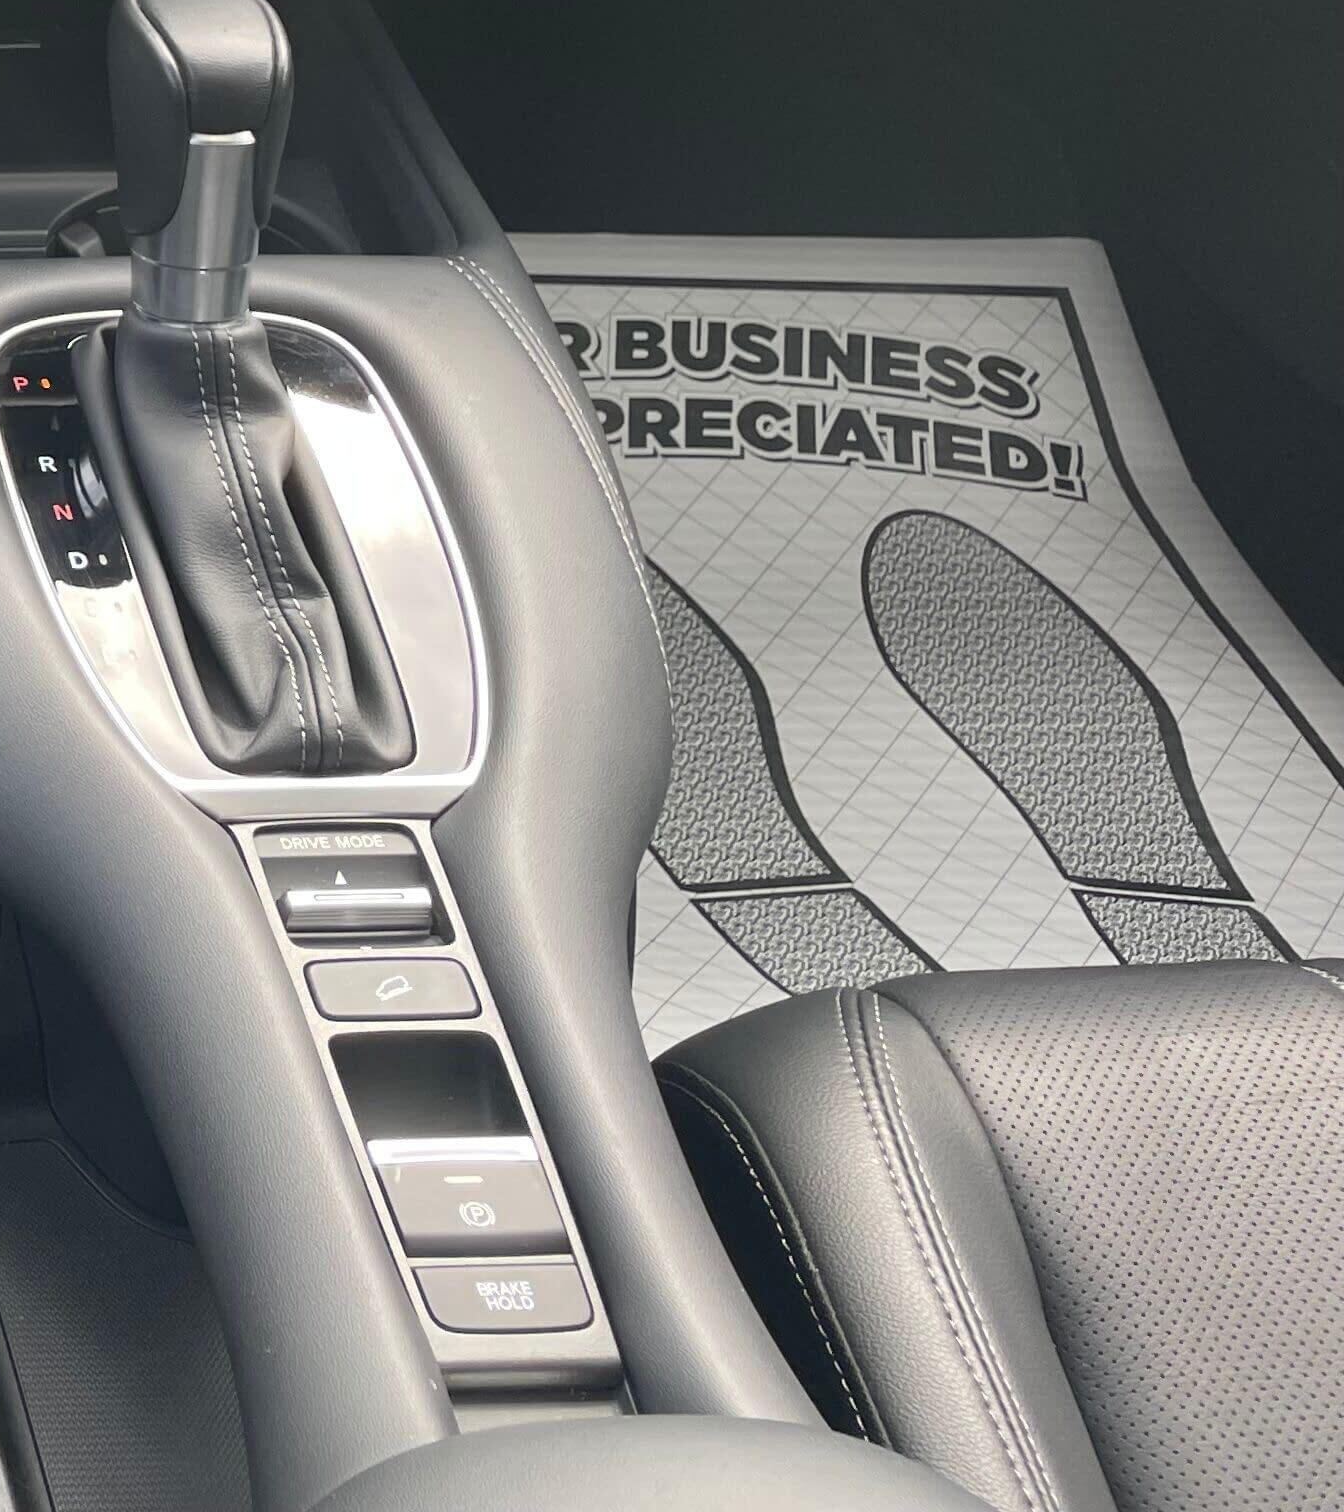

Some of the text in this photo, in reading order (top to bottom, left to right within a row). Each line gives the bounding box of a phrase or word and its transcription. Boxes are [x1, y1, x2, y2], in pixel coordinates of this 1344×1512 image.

[614, 319, 1032, 412] BUSINESS
[12, 375, 29, 392] P
[591, 398, 1080, 492] PRECIATED!
[37, 455, 58, 474] R
[52, 503, 74, 521] N
[67, 551, 89, 570] D
[279, 834, 385, 850] DRIVE MODE
[476, 1280, 534, 1297] BRAKE
[485, 1295, 535, 1311] HOLD
